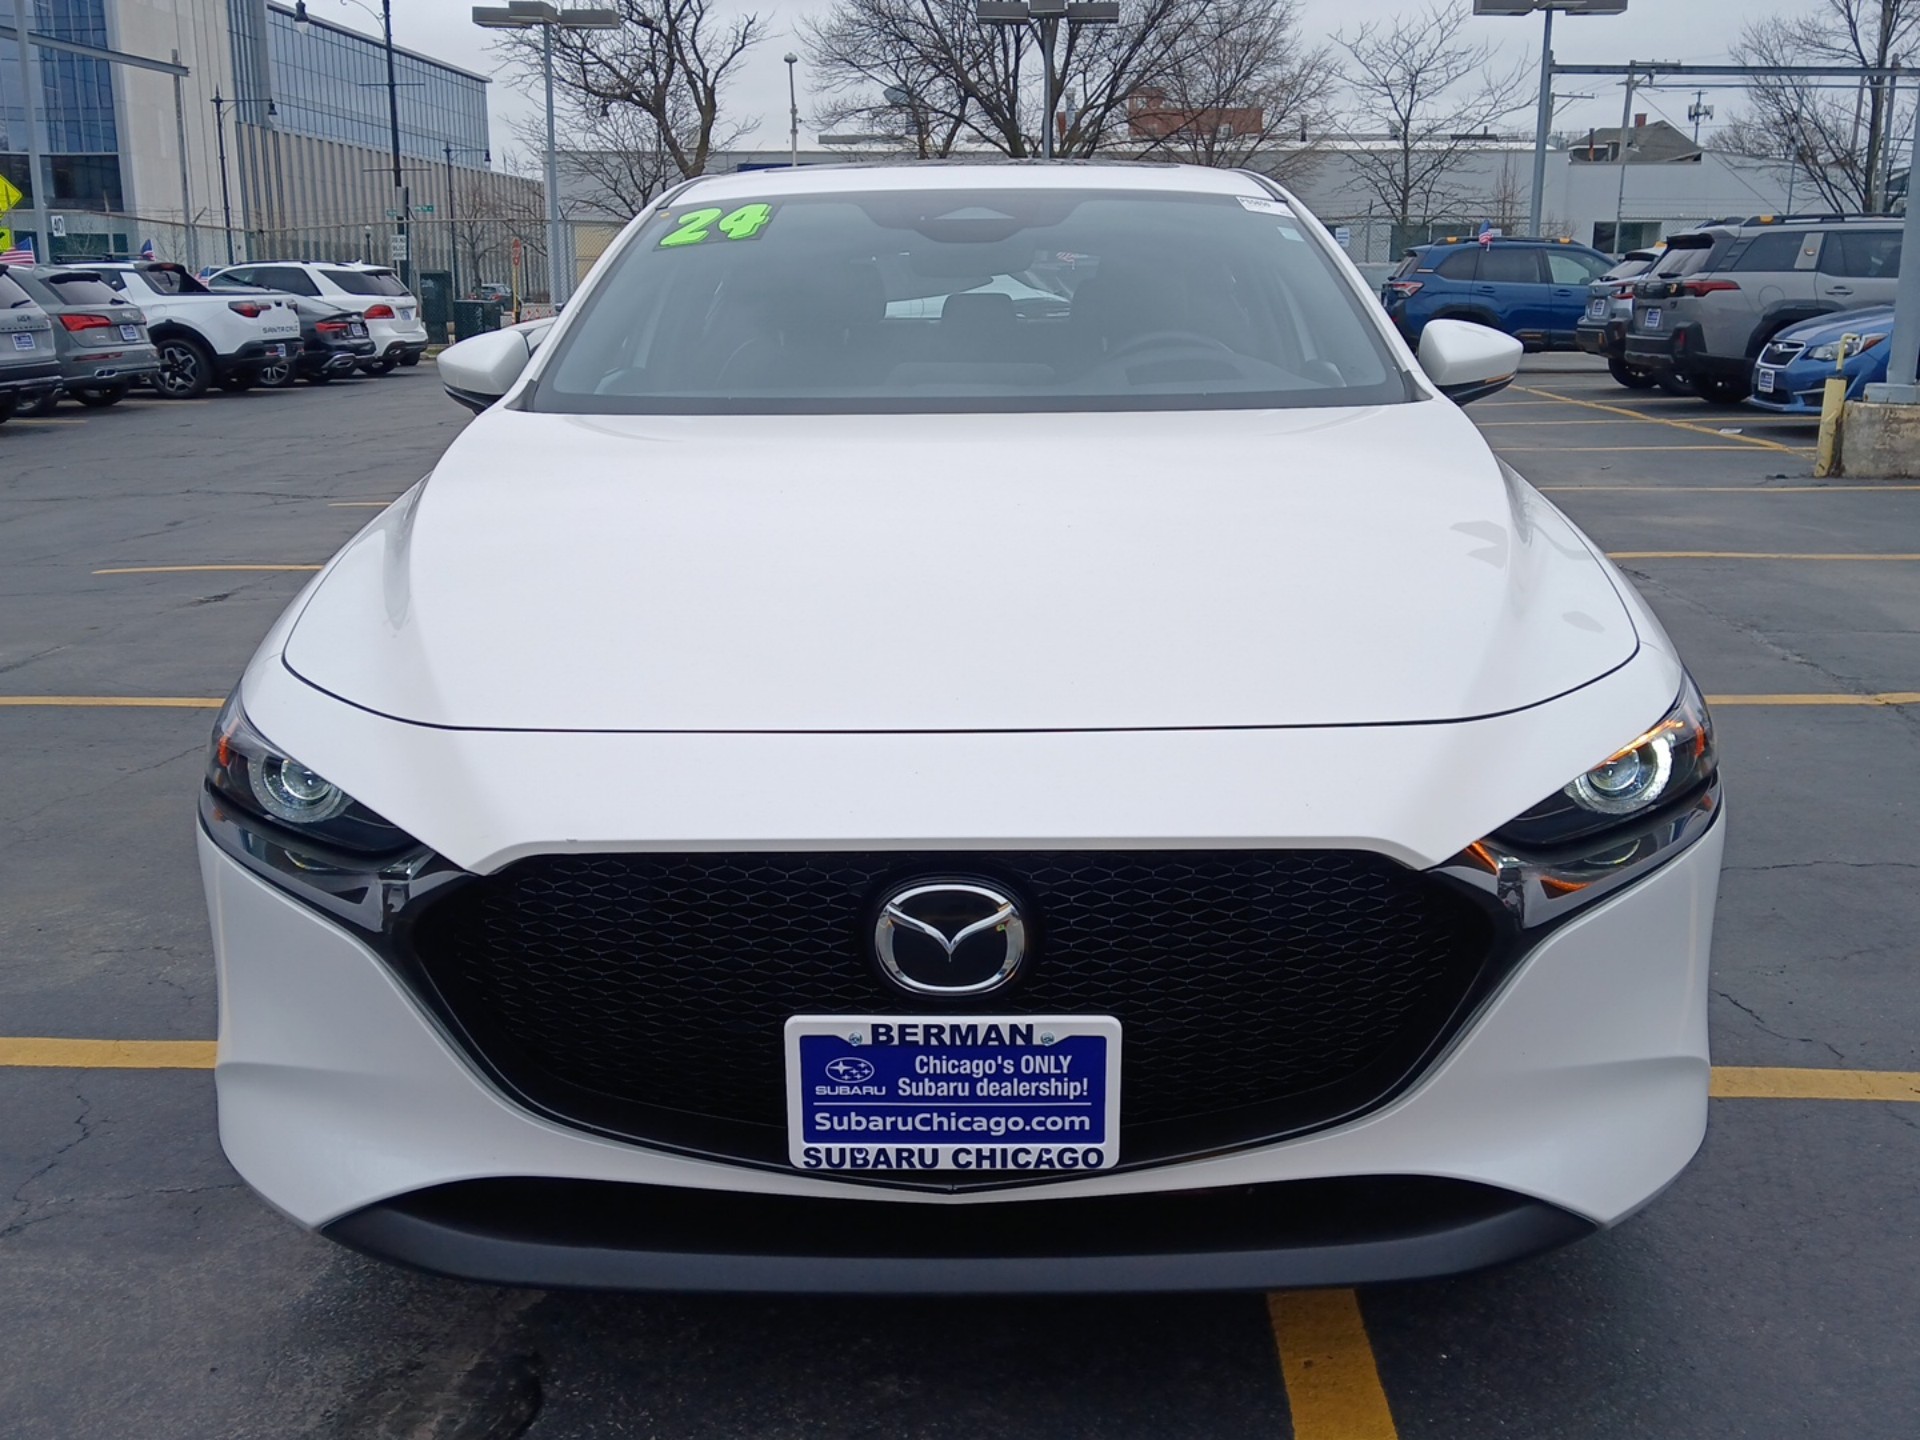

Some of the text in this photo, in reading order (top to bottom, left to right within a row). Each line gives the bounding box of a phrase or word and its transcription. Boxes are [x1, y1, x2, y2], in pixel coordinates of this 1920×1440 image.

[660, 203, 772, 248] 24
[871, 1024, 1034, 1046] BERMAN
[915, 1055, 1072, 1077] Chicago's ONLY
[815, 1085, 886, 1096] SUBARU
[898, 1078, 1088, 1100] Subaru dealership!
[814, 1111, 1091, 1136] SubaruChicago.com
[803, 1147, 1104, 1169] SUBARU CHICAGO
